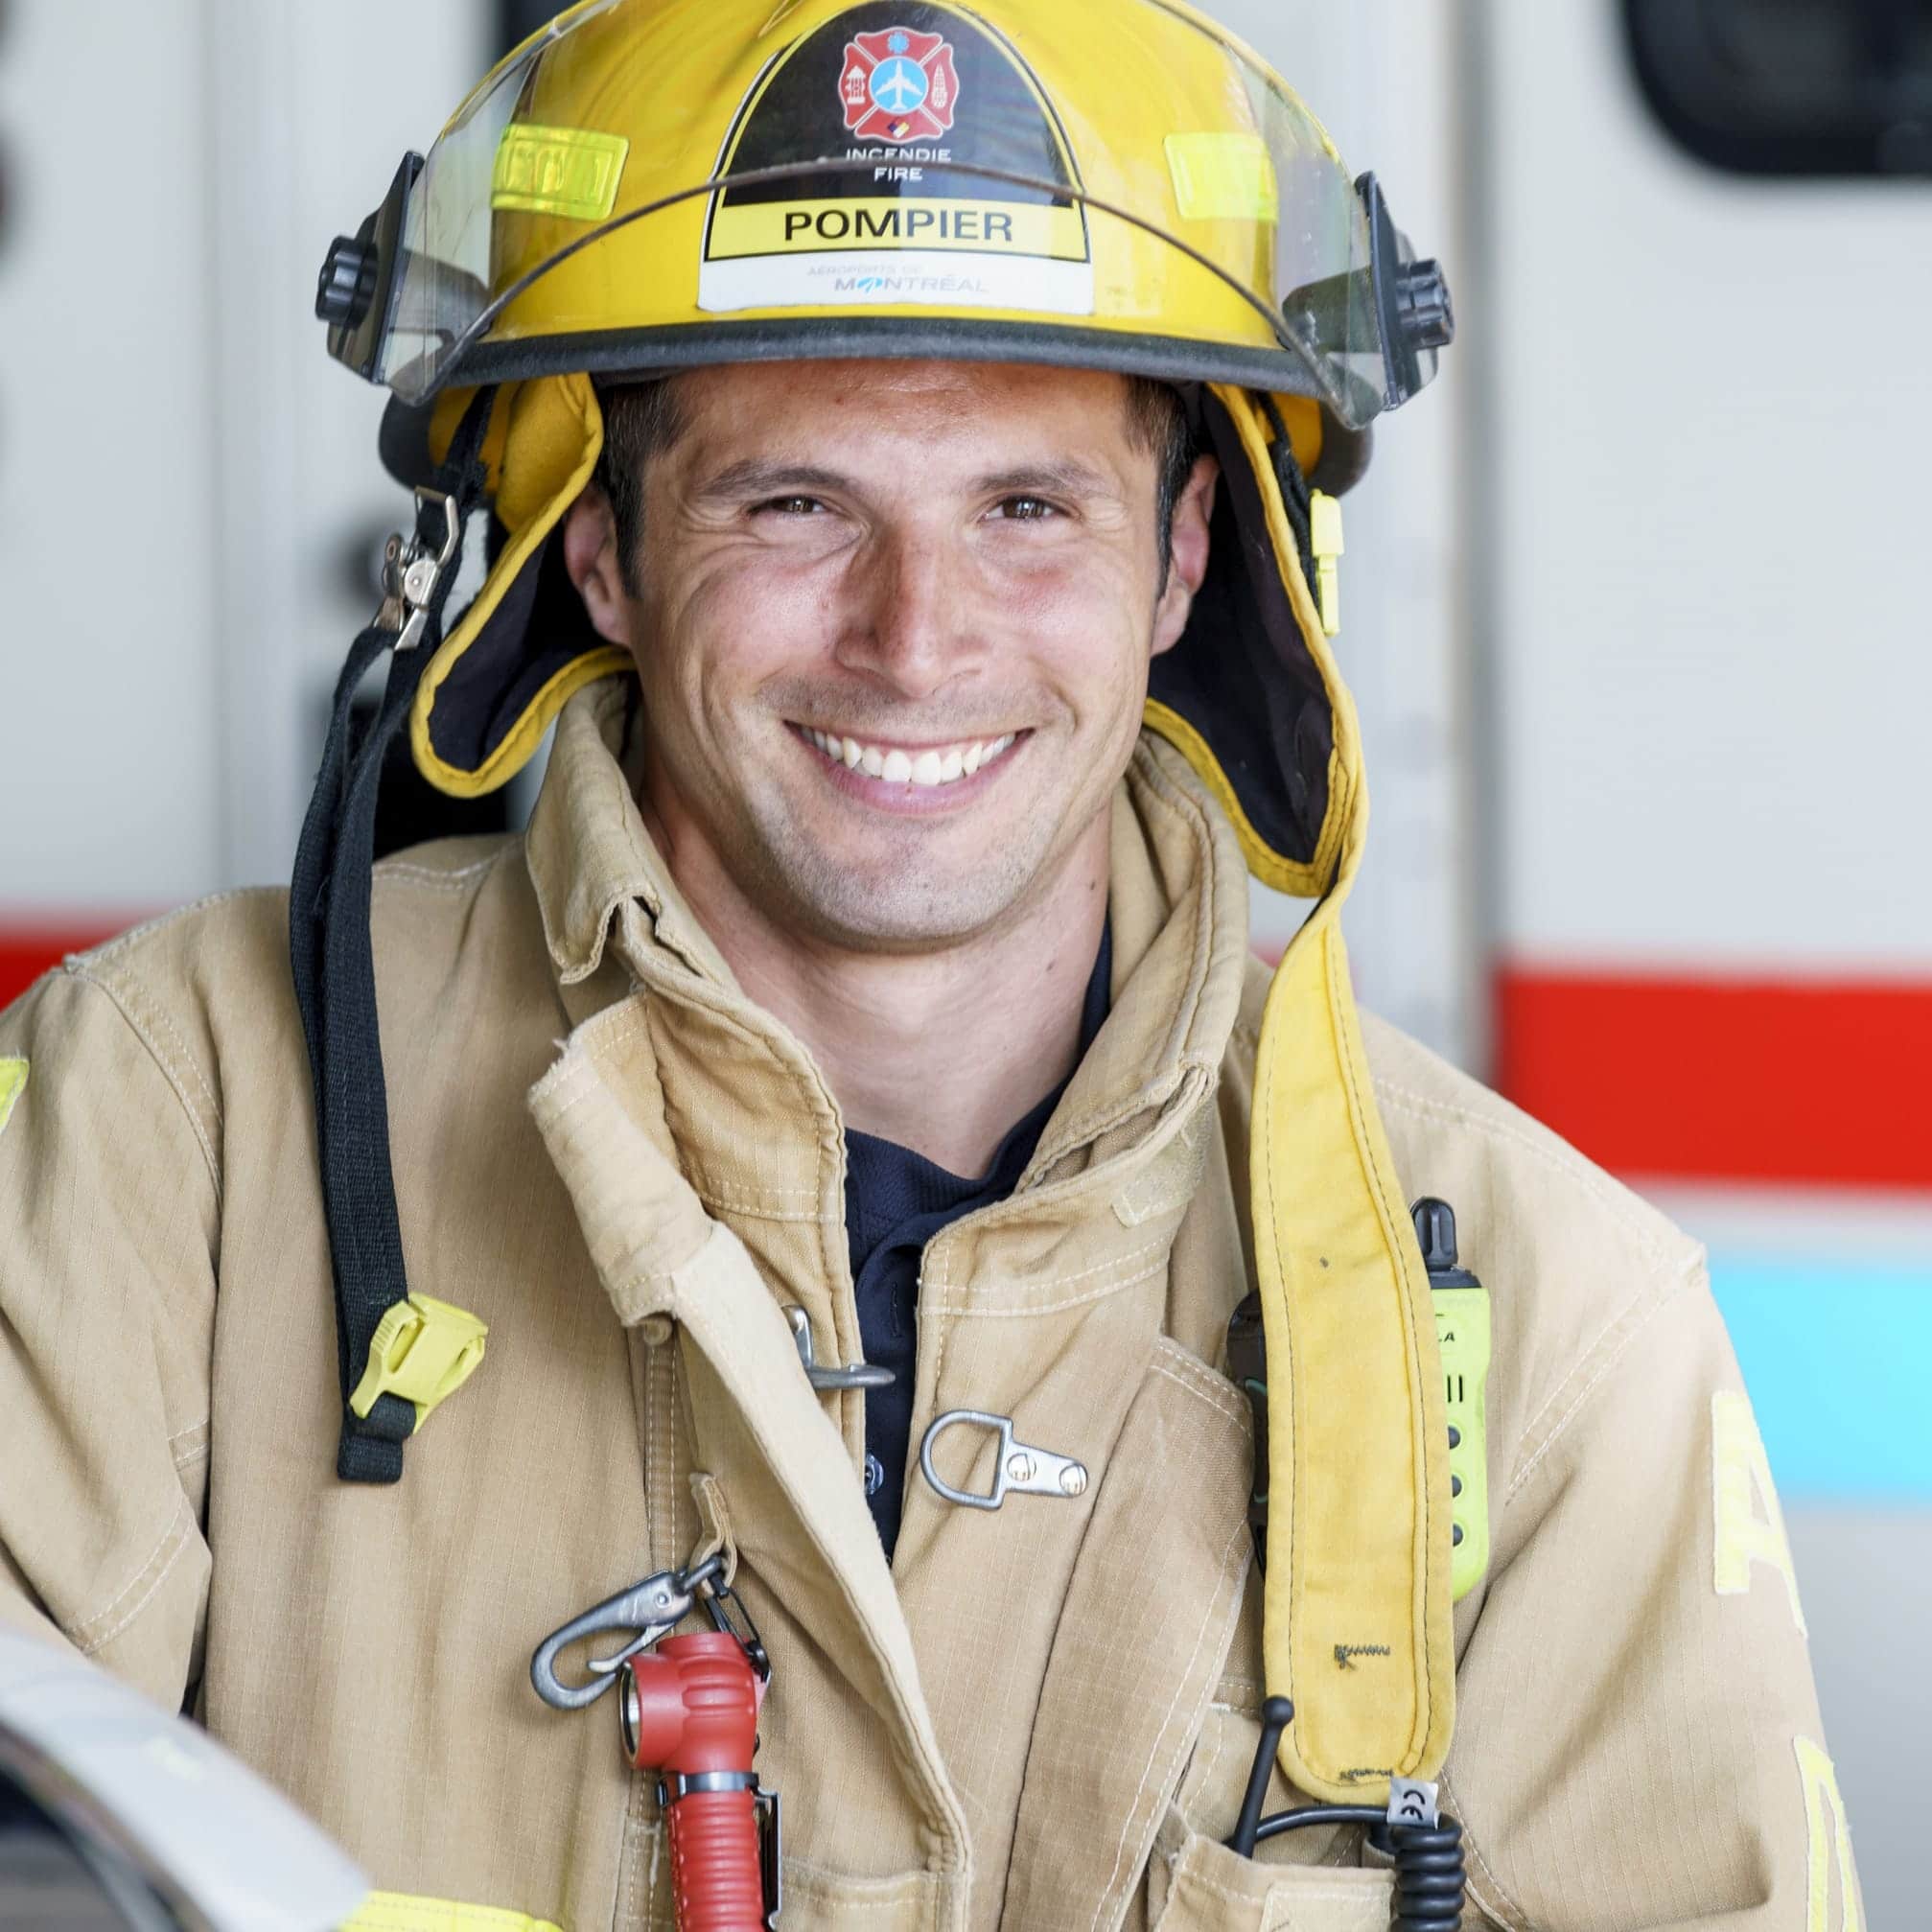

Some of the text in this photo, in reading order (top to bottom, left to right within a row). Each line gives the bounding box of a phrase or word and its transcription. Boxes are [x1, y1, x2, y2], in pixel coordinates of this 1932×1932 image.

[846, 148, 951, 162] INCENDIE
[874, 167, 922, 181] FIRE
[784, 209, 1013, 242] POMPIER
